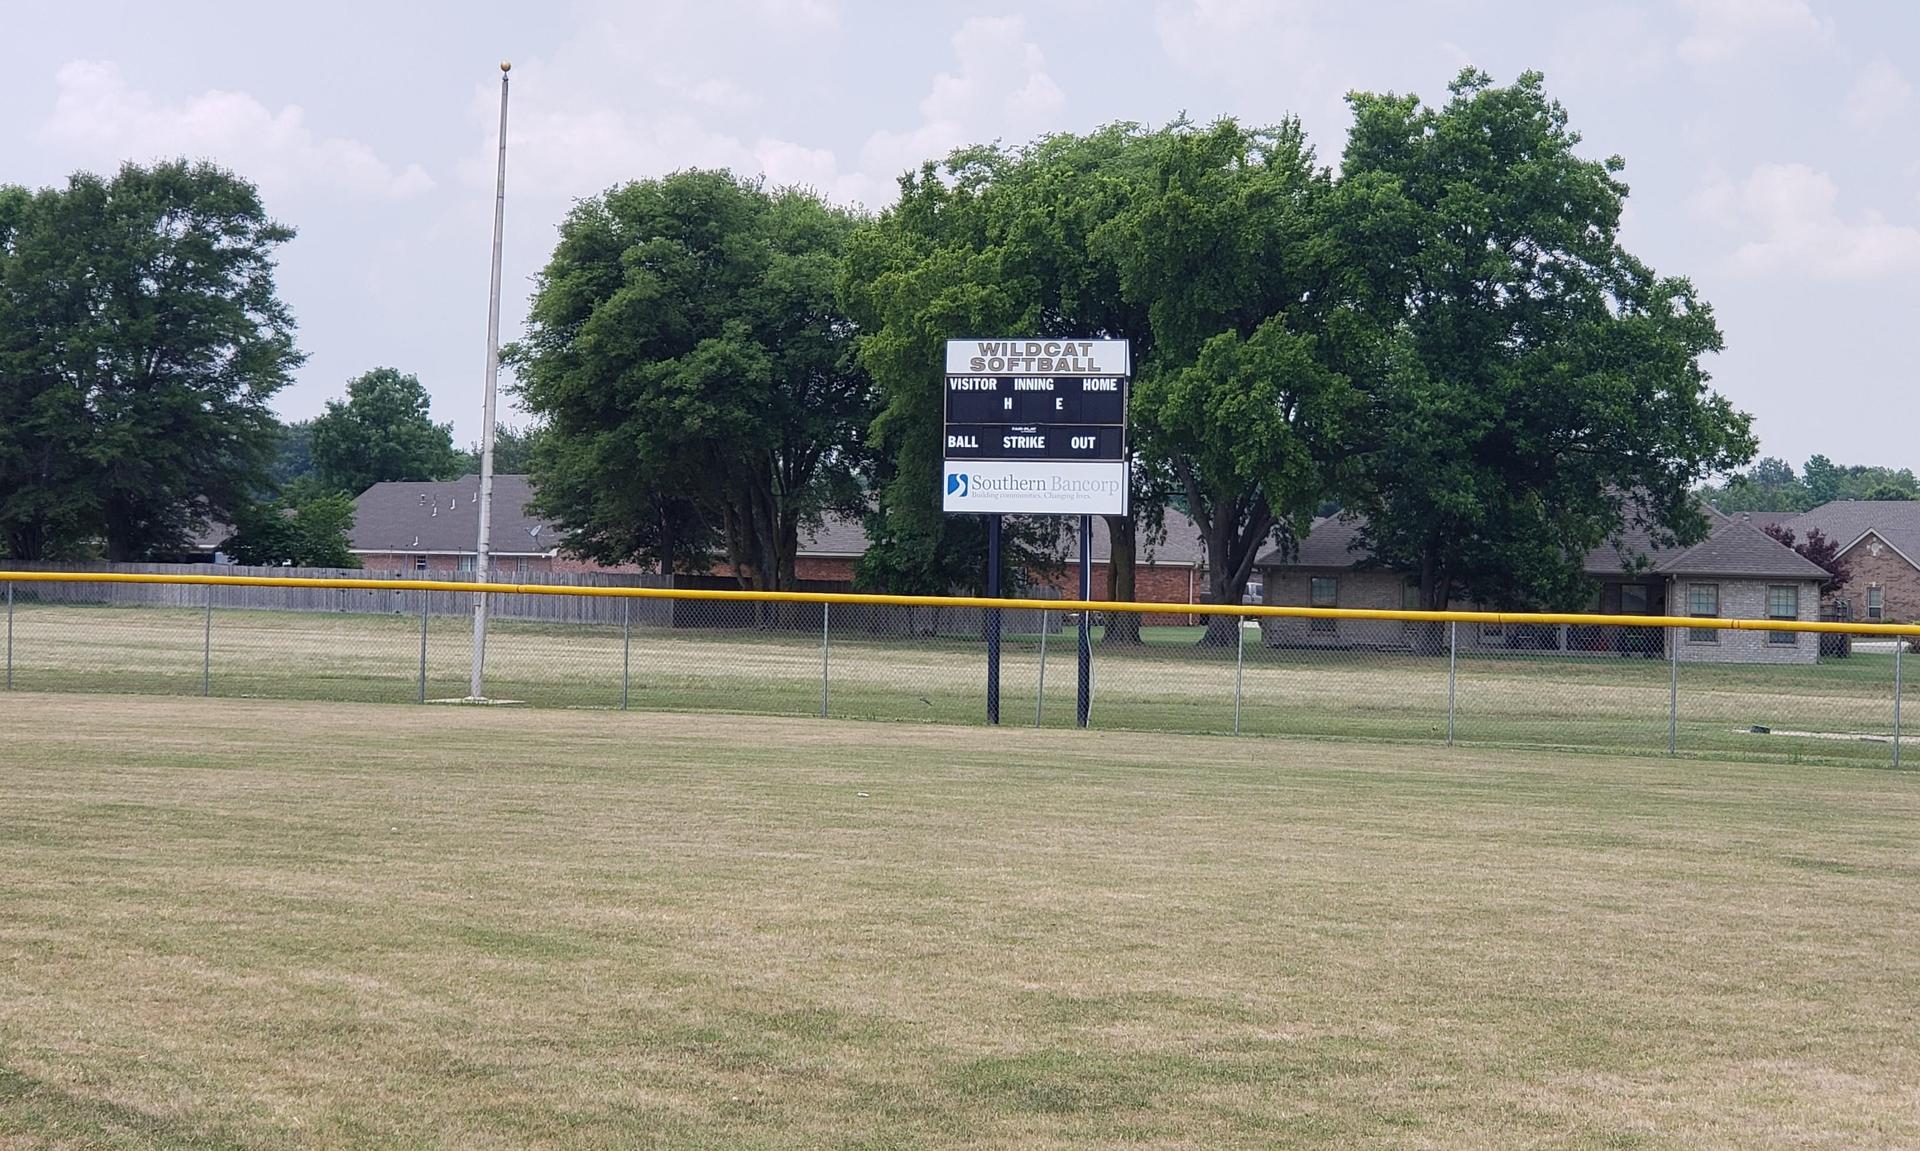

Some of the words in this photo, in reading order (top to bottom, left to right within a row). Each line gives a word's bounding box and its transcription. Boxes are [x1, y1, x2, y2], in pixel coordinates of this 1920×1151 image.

[978, 342, 1093, 357] WILDCAT
[970, 357, 1101, 372] SOFTBALL
[950, 378, 997, 391] VISITOR
[1014, 378, 1054, 391] INNING
[1083, 378, 1118, 391] HOME
[1004, 397, 1013, 410] H
[1055, 397, 1064, 410] E
[948, 435, 979, 448] BALL
[1003, 436, 1046, 449] STRIKE
[1071, 436, 1096, 449] OUT
[972, 474, 1046, 491] Southern
[1052, 475, 1119, 496] Bancorp
